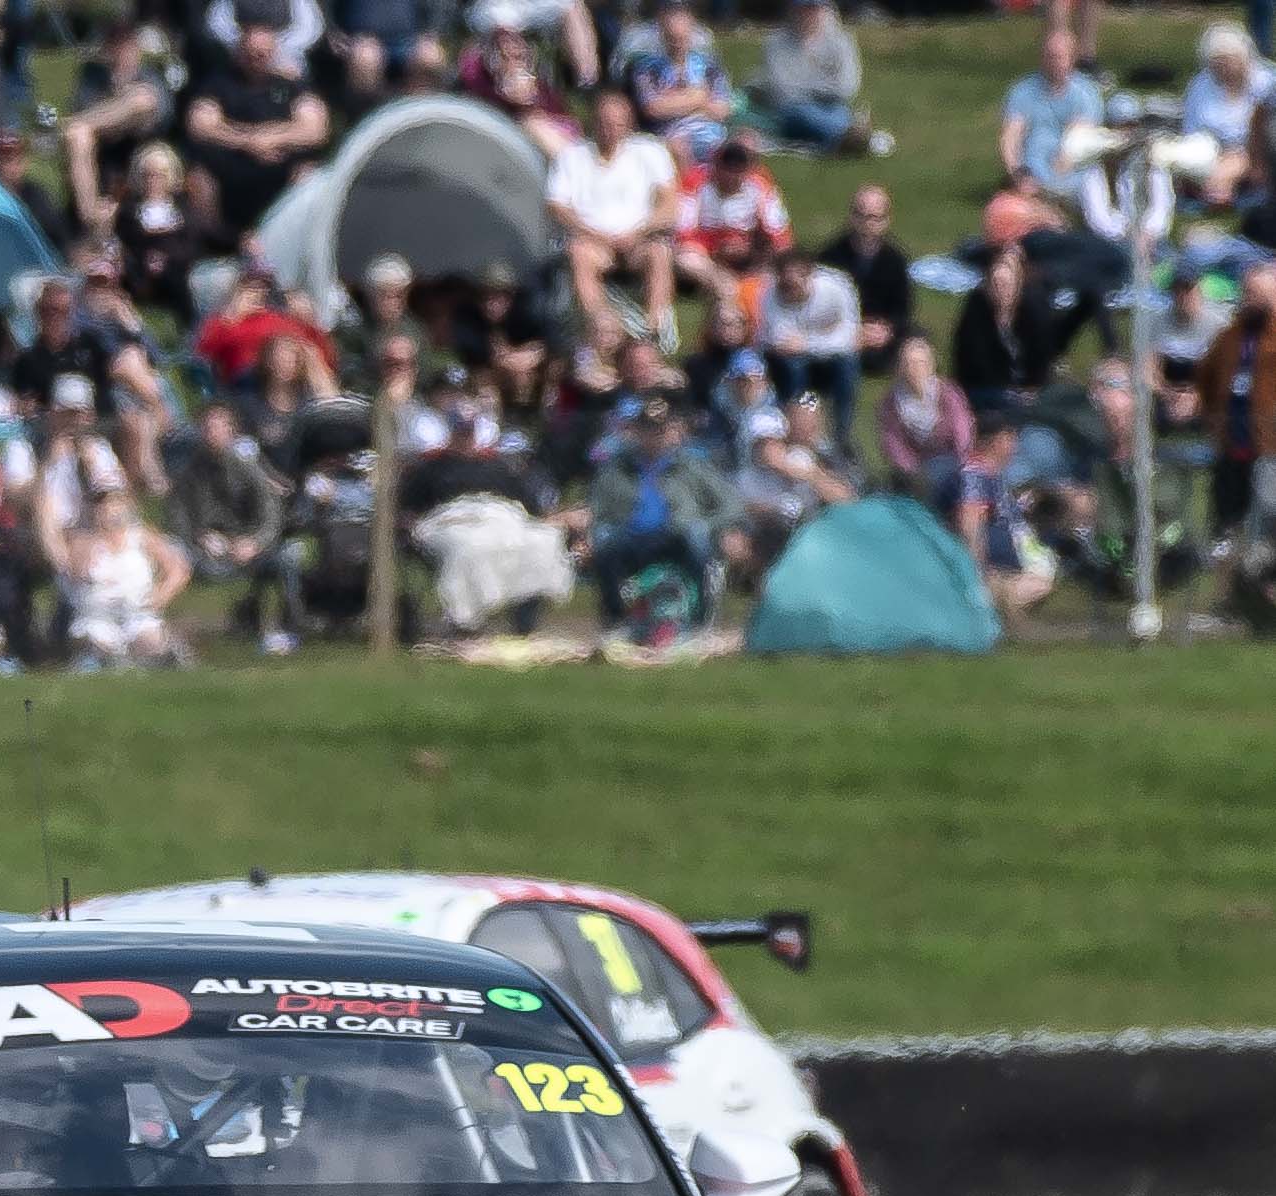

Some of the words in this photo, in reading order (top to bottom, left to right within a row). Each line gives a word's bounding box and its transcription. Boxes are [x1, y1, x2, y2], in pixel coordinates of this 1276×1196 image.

[190, 978, 486, 1006] AUTOBRITE
[275, 993, 423, 1017] Direct
[236, 1013, 328, 1031] CAR
[335, 1015, 453, 1036] CARE
[494, 1062, 625, 1117] 123
